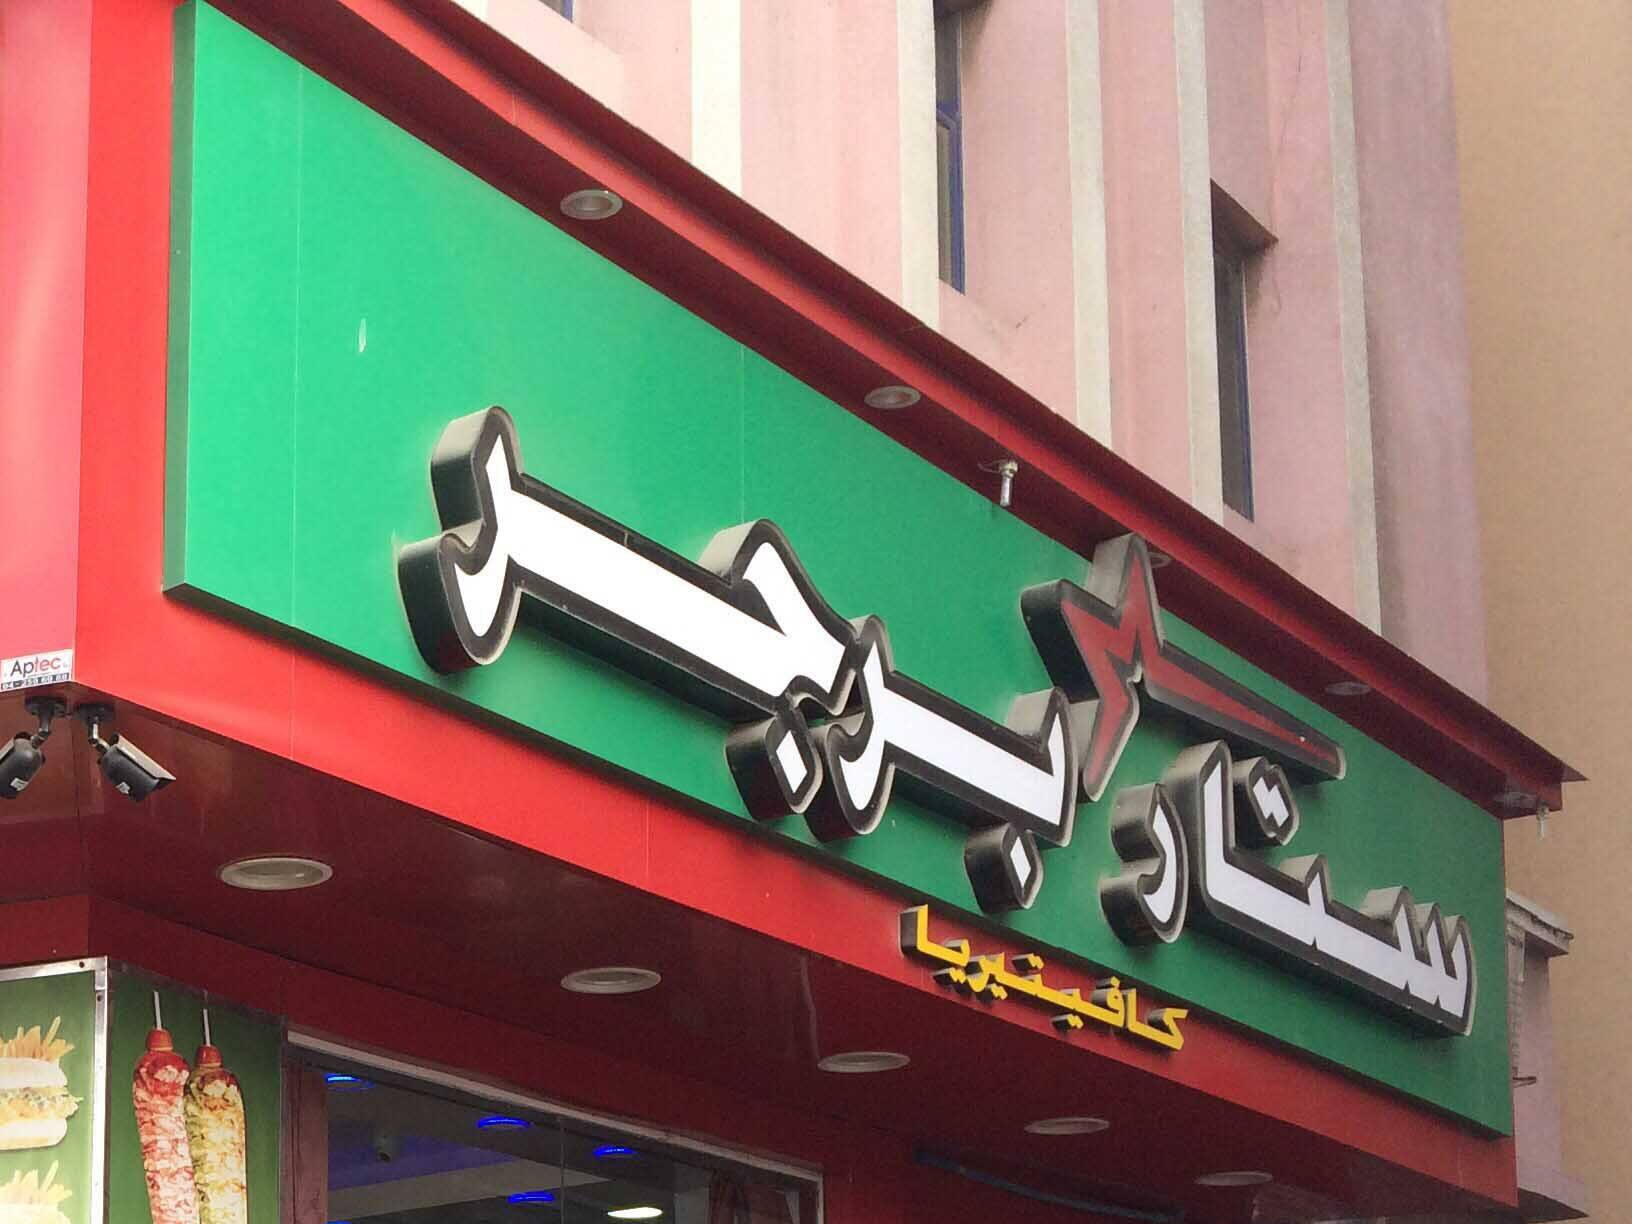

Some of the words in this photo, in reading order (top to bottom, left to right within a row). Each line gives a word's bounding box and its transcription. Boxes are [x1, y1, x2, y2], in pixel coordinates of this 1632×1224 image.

[10, 656, 61, 678] Aptec
[426, 408, 1076, 908] برجر
[1126, 742, 1473, 1035] ستار
